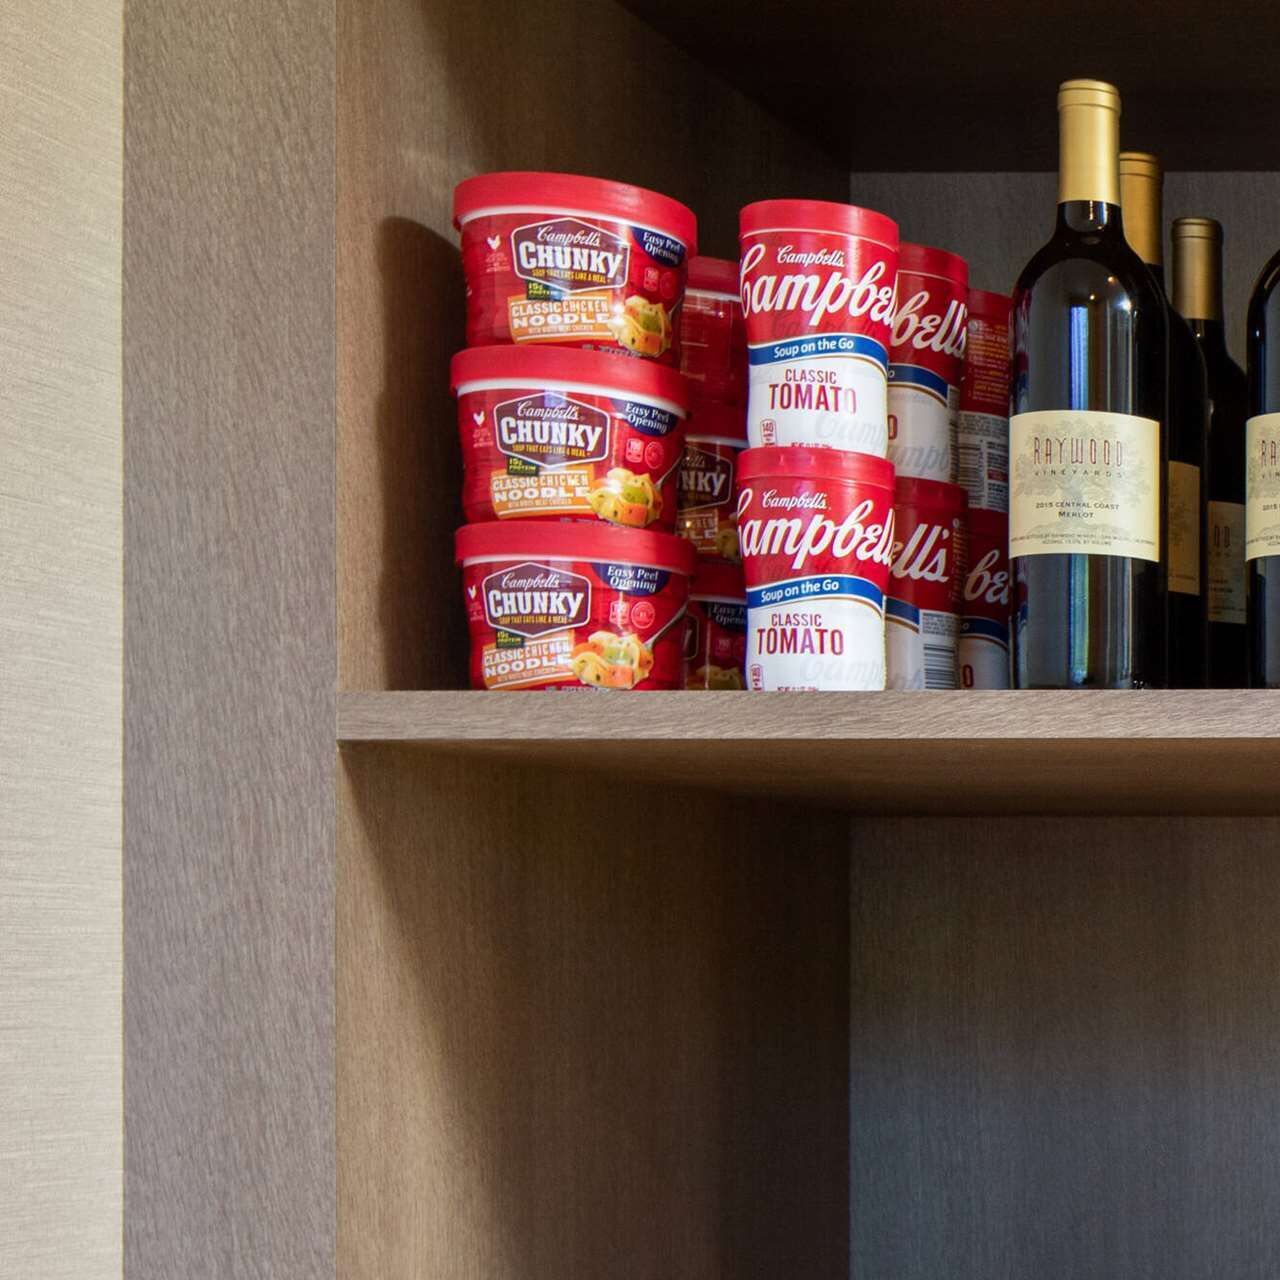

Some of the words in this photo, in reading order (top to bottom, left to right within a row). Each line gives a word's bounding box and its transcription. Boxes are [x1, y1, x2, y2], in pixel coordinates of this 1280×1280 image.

[537, 225, 601, 247] Campbell's
[519, 241, 623, 278] CHUNKY
[777, 245, 845, 267] Campbell's
[511, 300, 561, 317] CLASSIC
[511, 314, 611, 330] NOODLE
[774, 343, 799, 359] Soup
[800, 341, 816, 352] on
[817, 337, 837, 350] the
[838, 337, 854, 350] Go
[785, 369, 837, 384] CLASSIC
[769, 383, 857, 414] TOMATO
[517, 401, 580, 421] Campbell's
[625, 403, 649, 418] Easy
[627, 413, 668, 433] Opening
[501, 416, 602, 452] CHUNKY
[1034, 437, 1123, 467] RAYWOOD
[493, 476, 538, 490] CLASSIC
[1035, 469, 1123, 479] VINEYARDS
[493, 486, 591, 504] NOODLE
[763, 489, 829, 510] Campbell's
[1055, 501, 1091, 509] CENTRAL
[1094, 502, 1120, 510] COAST
[502, 573, 560, 590] Campbell's
[608, 566, 635, 580] Easy
[637, 568, 659, 581] Peel
[610, 576, 657, 592] Opening
[761, 590, 783, 603] Soup
[785, 586, 799, 597] on
[801, 582, 820, 594] the
[822, 579, 839, 591] Go
[488, 589, 584, 619] CHUNKY
[771, 613, 822, 626] CLASSIC
[757, 628, 844, 655] TOMATO
[484, 653, 574, 679] NOODLE
